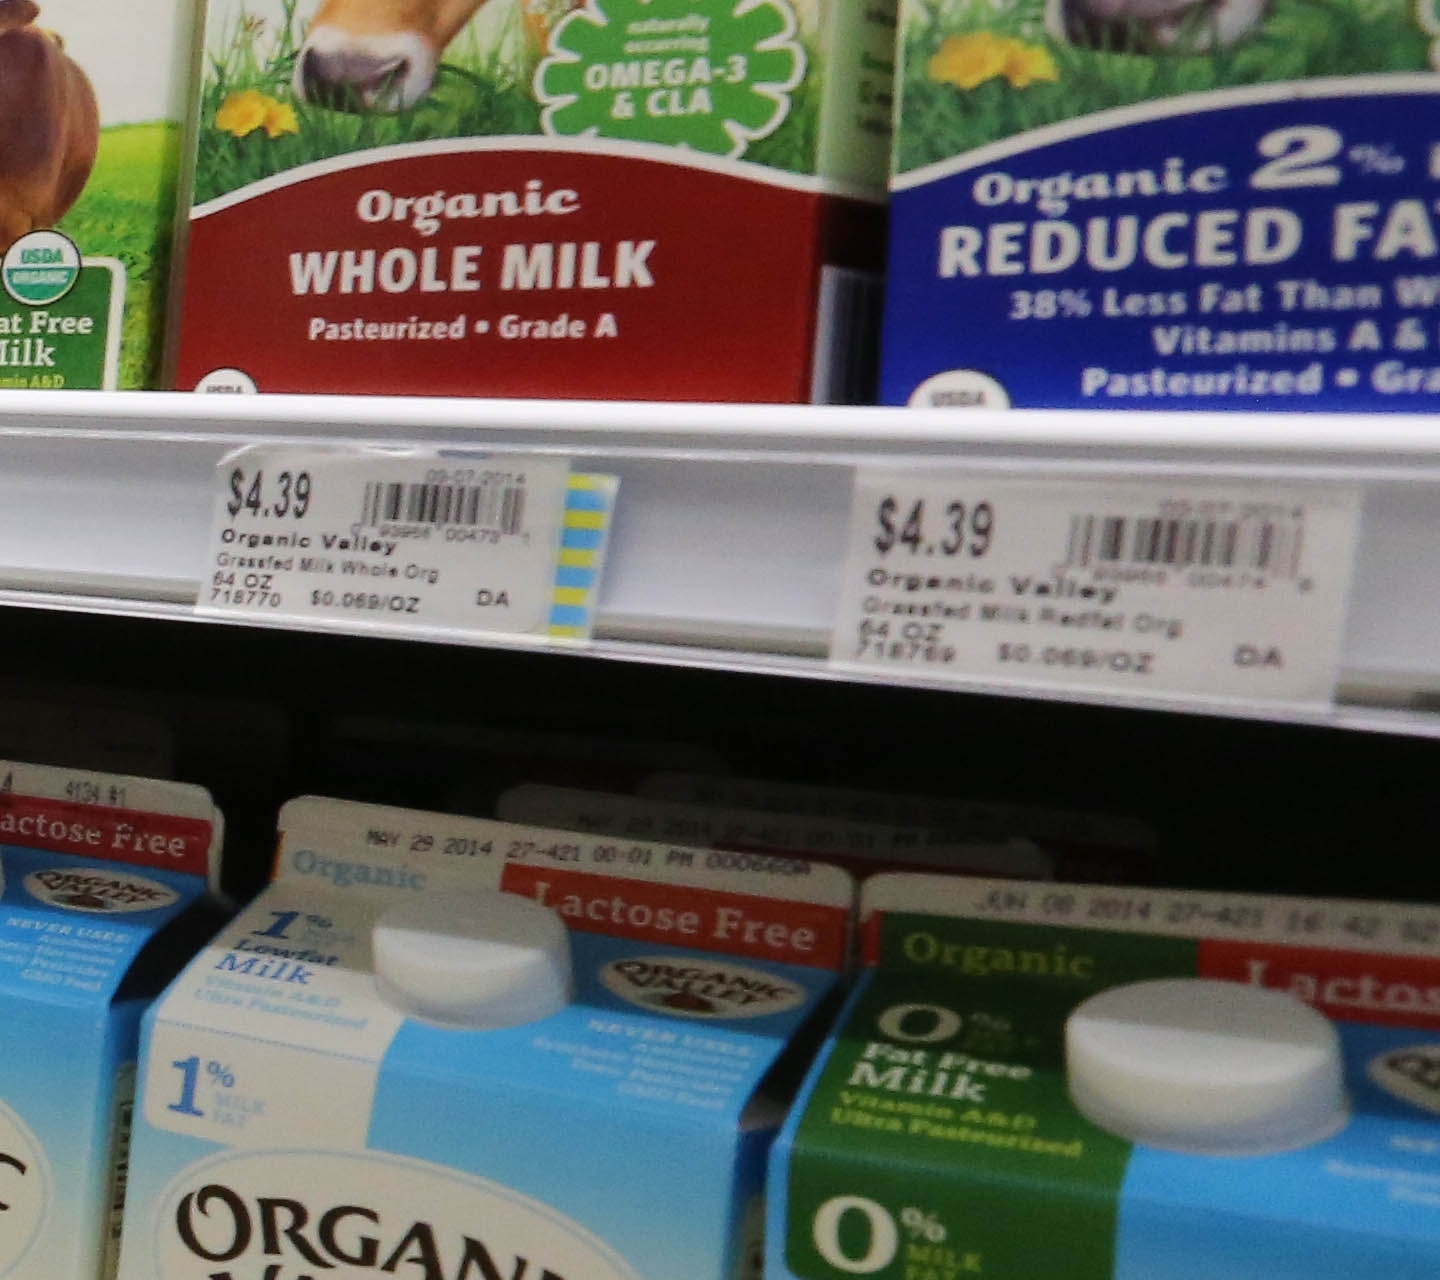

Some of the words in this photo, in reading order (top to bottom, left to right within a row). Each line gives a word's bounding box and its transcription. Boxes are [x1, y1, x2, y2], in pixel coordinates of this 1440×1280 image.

[584, 54, 748, 90] OMEGA-3
[611, 92, 635, 118] &
[646, 88, 712, 116] CLA
[973, 157, 1228, 217] Organic
[356, 178, 580, 239] Organic
[938, 207, 1303, 279] REDUCED
[289, 243, 484, 298] WHOLE
[500, 240, 657, 292] MILK
[1010, 288, 1092, 321] 38%
[1103, 287, 1187, 318] Less
[1200, 283, 1263, 314] Fat
[1280, 279, 1380, 311] Than
[28, 311, 94, 334] Free
[307, 314, 467, 344] Pasteurized
[496, 312, 587, 341] Grade
[593, 312, 619, 339] A
[1153, 324, 1336, 355] Vitamins
[1082, 363, 1323, 397] Pasteurized
[227, 467, 312, 520] $4.39
[221, 528, 310, 551] Organic
[323, 535, 397, 556] Valley
[874, 496, 994, 557] $4.39
